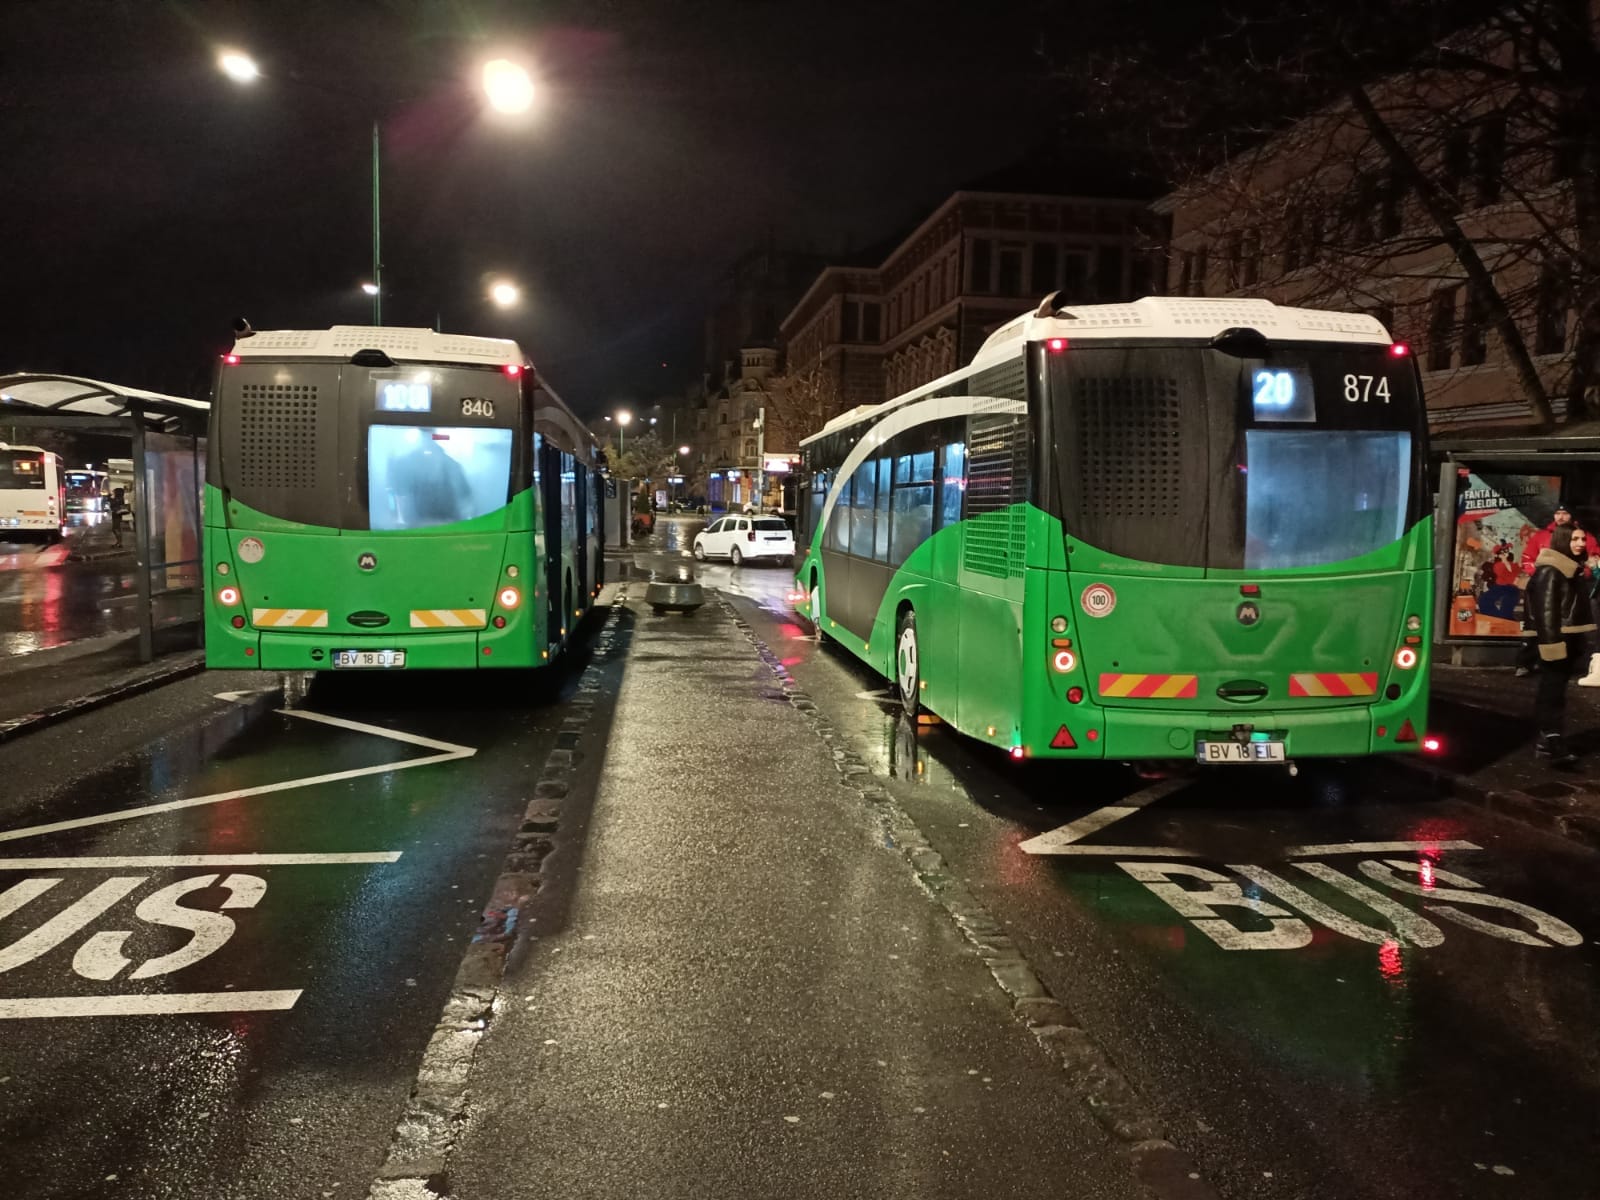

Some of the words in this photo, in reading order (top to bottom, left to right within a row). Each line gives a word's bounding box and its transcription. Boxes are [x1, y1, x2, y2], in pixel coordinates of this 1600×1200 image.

[1255, 372, 1293, 404] 20
[1343, 374, 1391, 403] 874
[462, 399, 493, 417] 840
[1464, 489, 1491, 499] FANTA
[1464, 498, 1497, 509] ZILELOR
[1091, 594, 1106, 606] 100
[341, 653, 358, 664] BV
[363, 653, 374, 664] 18
[1209, 744, 1230, 759] BV
[1236, 744, 1250, 759] 18
[1114, 859, 1584, 951] BUS
